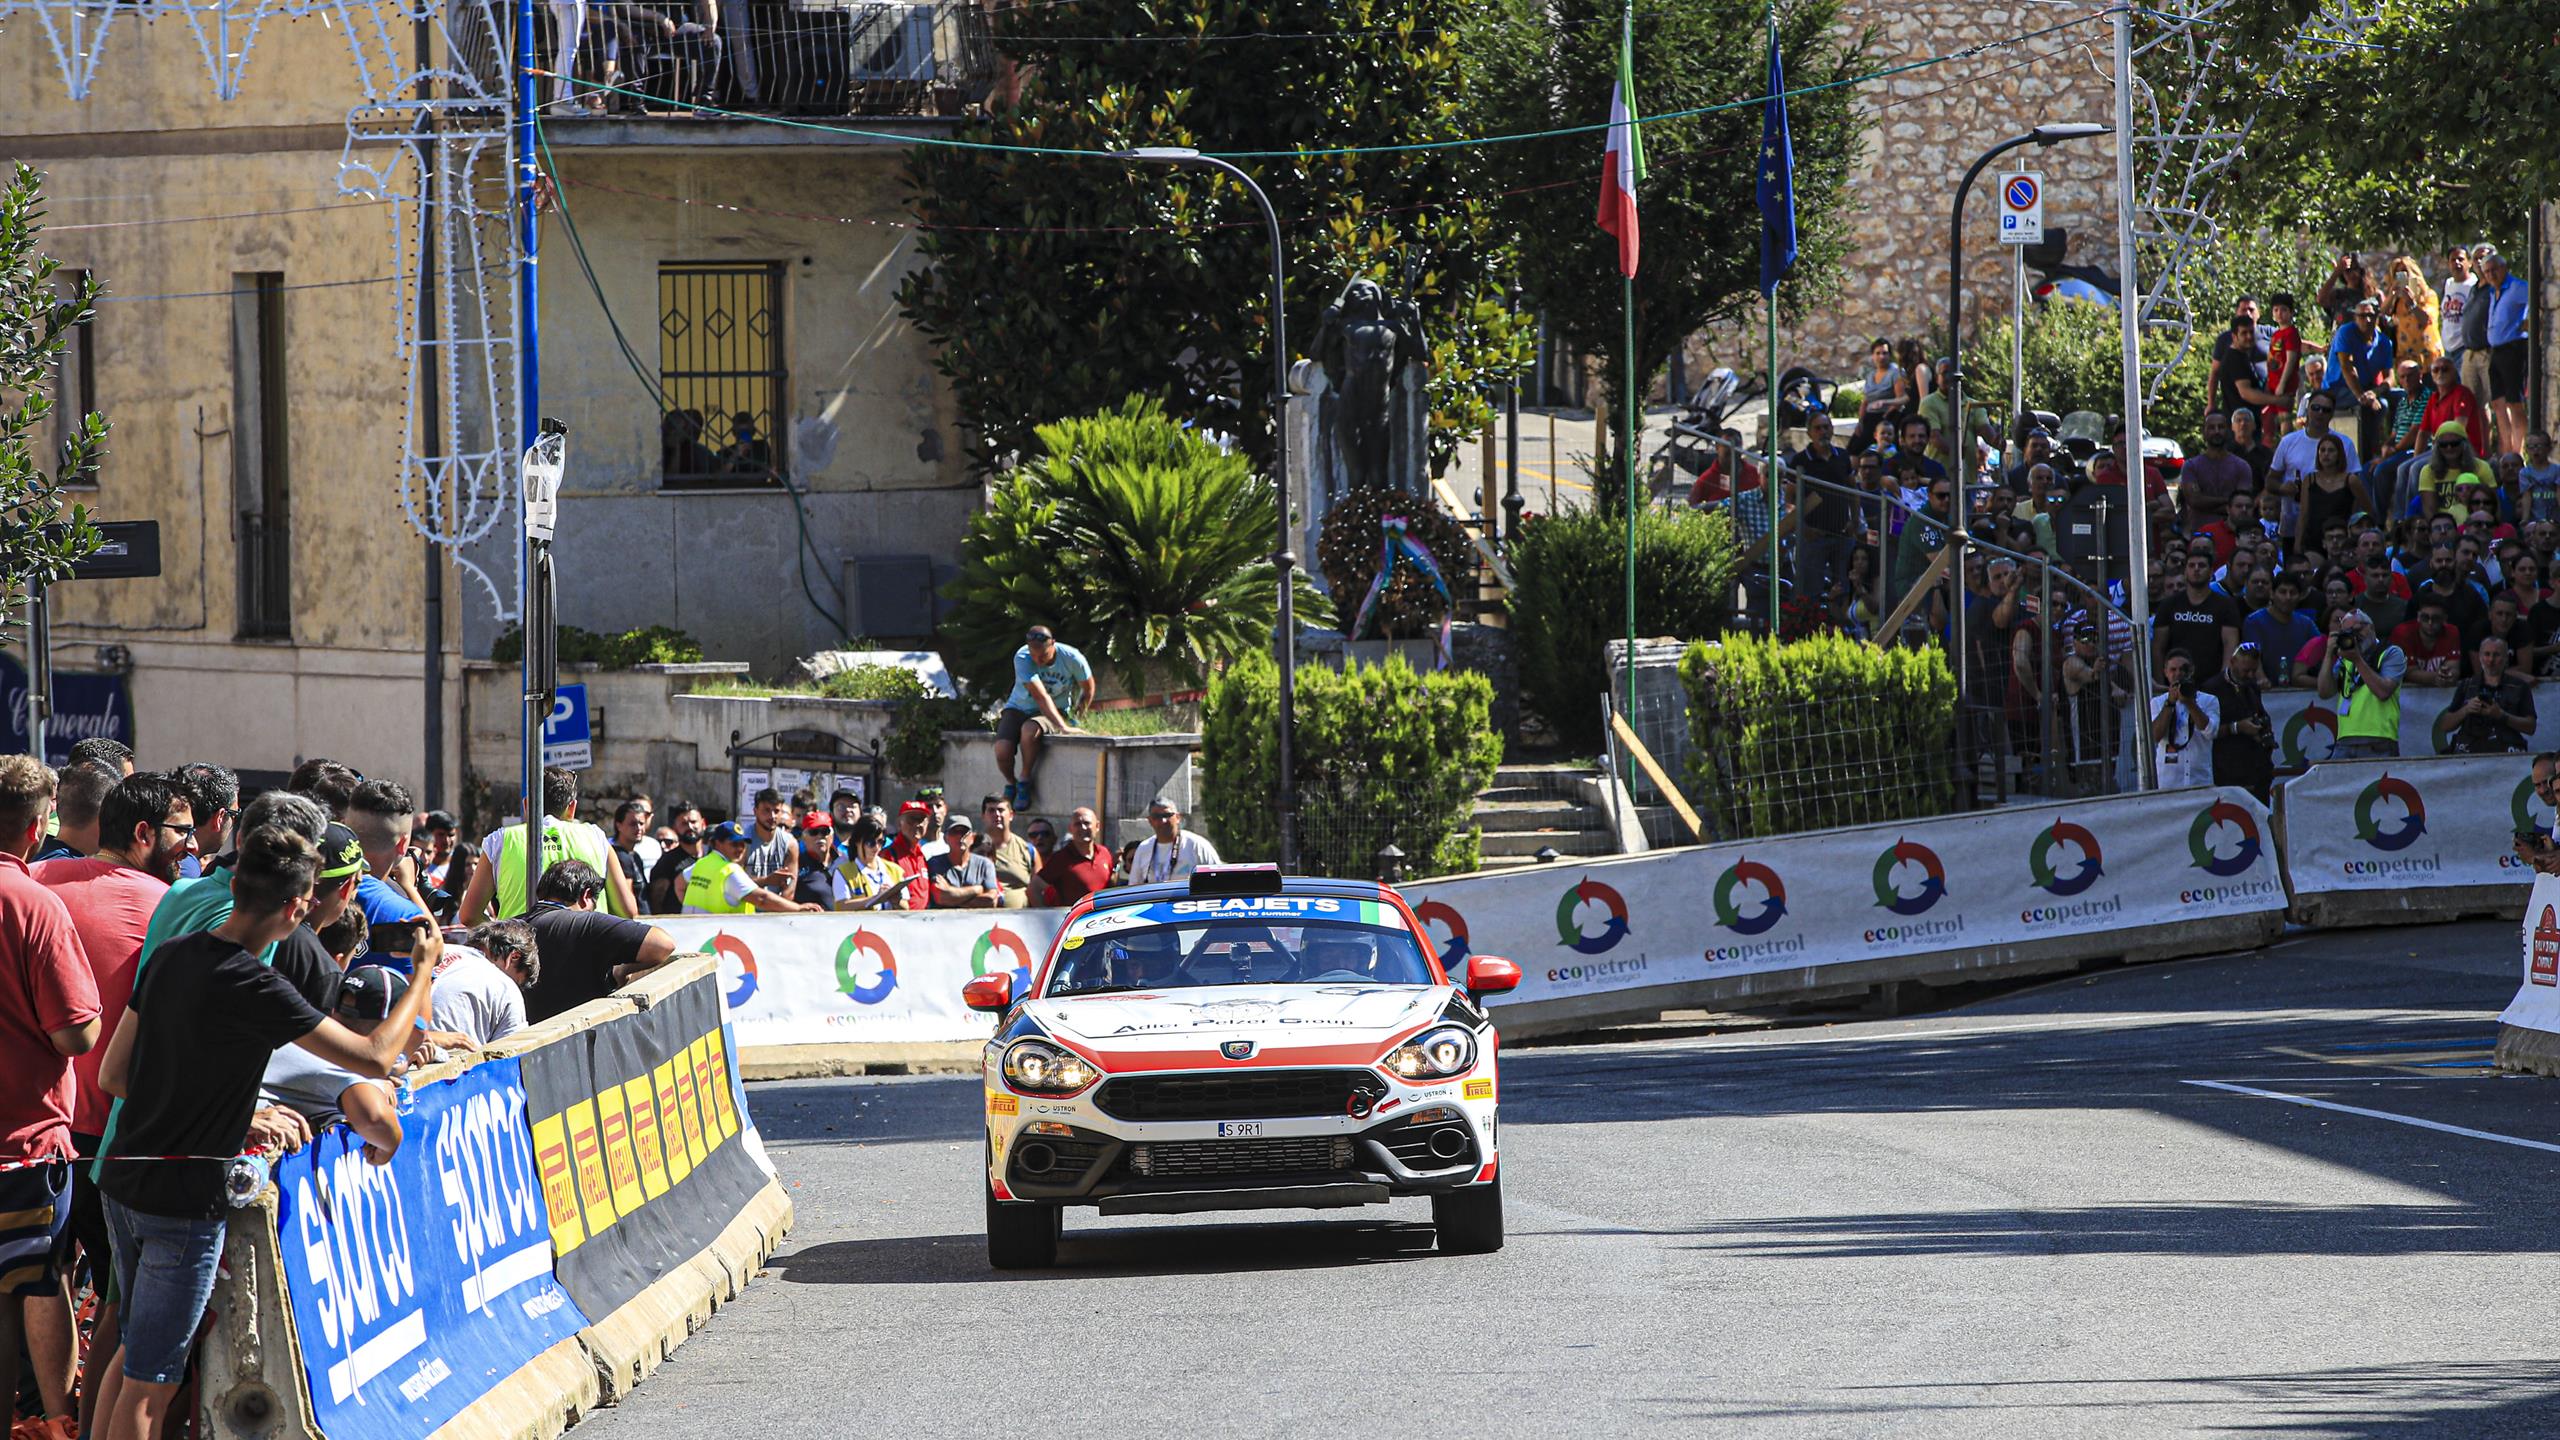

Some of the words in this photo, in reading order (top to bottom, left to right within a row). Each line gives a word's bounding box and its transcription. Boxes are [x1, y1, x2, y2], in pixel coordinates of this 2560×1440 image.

[2174, 611, 2213, 624] adidas
[545, 695, 574, 736] P
[2344, 853, 2442, 877] ecopetrol
[2180, 874, 2281, 903] ecopetrol
[1172, 898, 1340, 914] SEAJETS
[2021, 894, 2122, 923] ecopetrol
[1864, 914, 1965, 943] ecopetrol
[1704, 933, 1805, 962] ecopetrol
[1547, 953, 1648, 982] ecopetrol
[1278, 1018, 1354, 1026] Group
[1465, 1081, 1493, 1097] PIRELLI
[632, 1099, 662, 1176] PIRELLI
[1225, 1124, 1234, 1136] S
[1237, 1124, 1260, 1136] 9R1
[603, 1111, 635, 1192] PIRELLI
[574, 1126, 608, 1209] PIRELLI
[539, 1142, 577, 1229] PIRELLI
[436, 1086, 538, 1319] sparco
[298, 1149, 415, 1406] sparco
